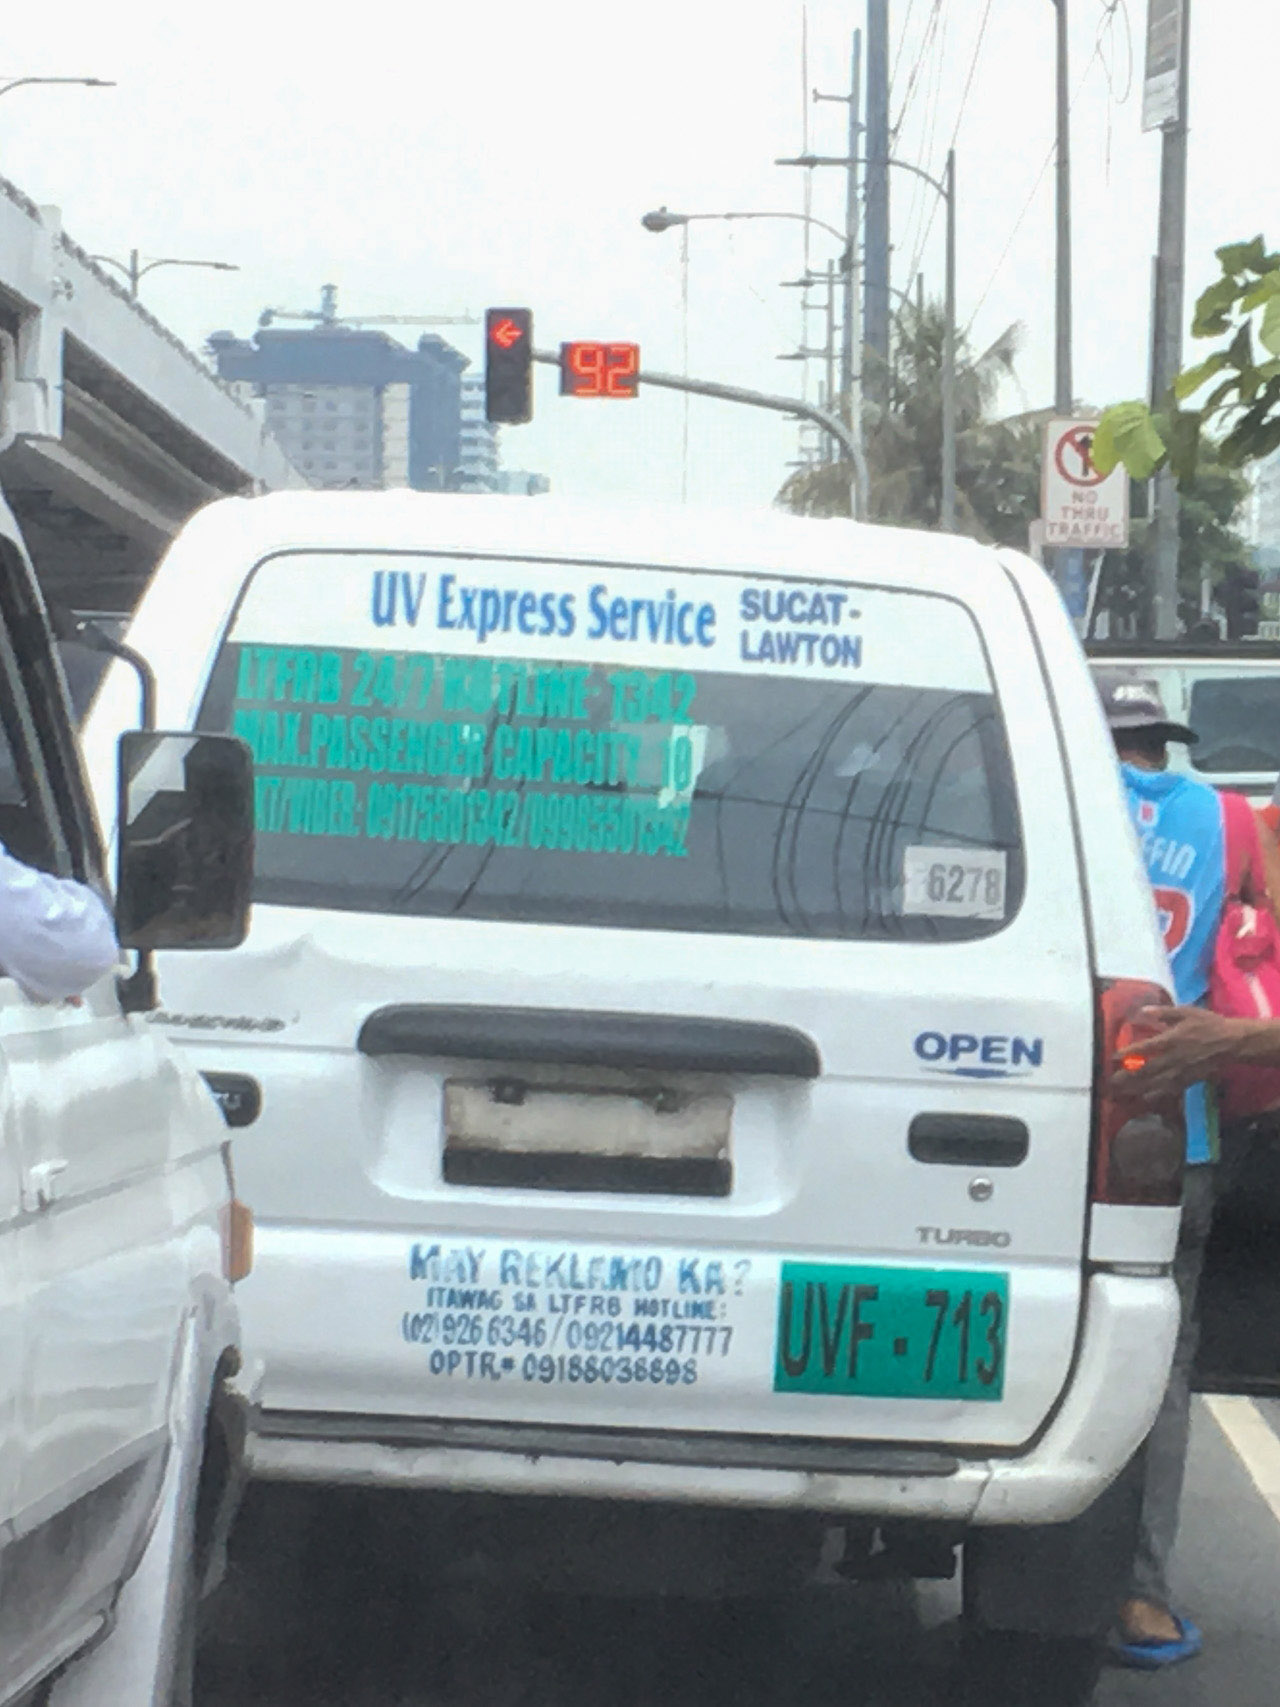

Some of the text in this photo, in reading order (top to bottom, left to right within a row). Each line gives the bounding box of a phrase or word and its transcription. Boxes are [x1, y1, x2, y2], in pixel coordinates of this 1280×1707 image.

[572, 343, 637, 396] 92
[1061, 506, 1109, 521] THRU
[1072, 490, 1098, 504] NO
[1049, 522, 1119, 535] TRAFFIC
[372, 570, 716, 648] UV Express Service
[740, 588, 862, 627] SUCAT-
[740, 629, 862, 669] LAWTON
[236, 647, 342, 704] LTFRB
[351, 651, 434, 709] 24/7
[608, 669, 697, 725] 1342
[926, 863, 1002, 907] 6278
[914, 1031, 1044, 1067] OPEN
[915, 1226, 1012, 1248] TURBO
[409, 1243, 486, 1282] MAY
[677, 1257, 752, 1297] KA?
[426, 1286, 503, 1311] ITAWAG
[512, 1291, 537, 1313] SA
[548, 1293, 622, 1318] LTFRB
